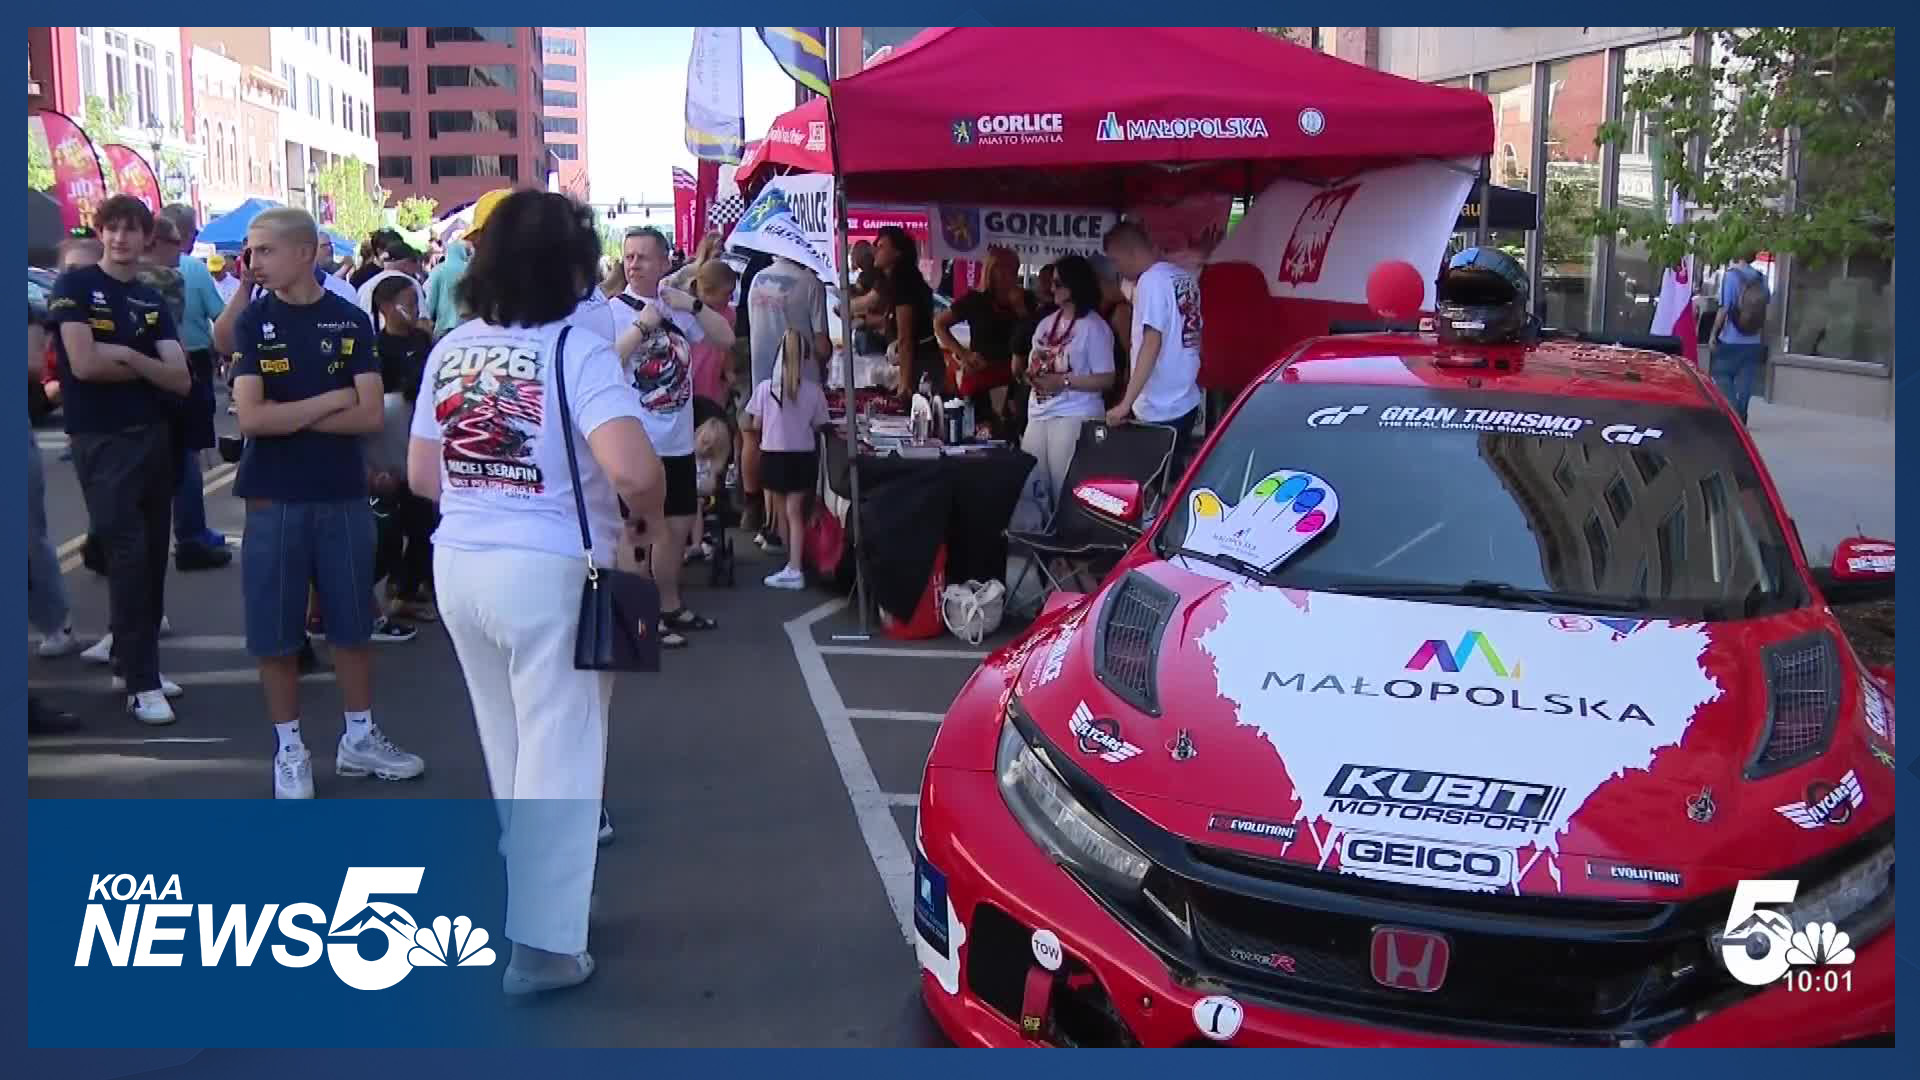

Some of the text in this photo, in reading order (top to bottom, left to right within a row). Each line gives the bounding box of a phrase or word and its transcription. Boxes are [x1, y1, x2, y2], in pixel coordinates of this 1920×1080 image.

[978, 113, 1063, 134] GORLICE
[1127, 117, 1268, 141] MAŁOPOLSKA
[979, 135, 1018, 145] MIASTO
[984, 211, 1102, 239] GORLICE
[439, 346, 537, 381] 2026
[1380, 407, 1583, 431] GRAN TURISMO
[1404, 421, 1438, 429] REAL
[487, 463, 538, 481] SERAFIN
[1261, 671, 1656, 727] MAŁOPOLSKA
[1337, 766, 1545, 814] KUBIT
[1328, 799, 1550, 835] MOTORSPORT
[1348, 839, 1502, 878] GEICO
[1033, 939, 1060, 961] TOW
[1203, 999, 1238, 1034] T
